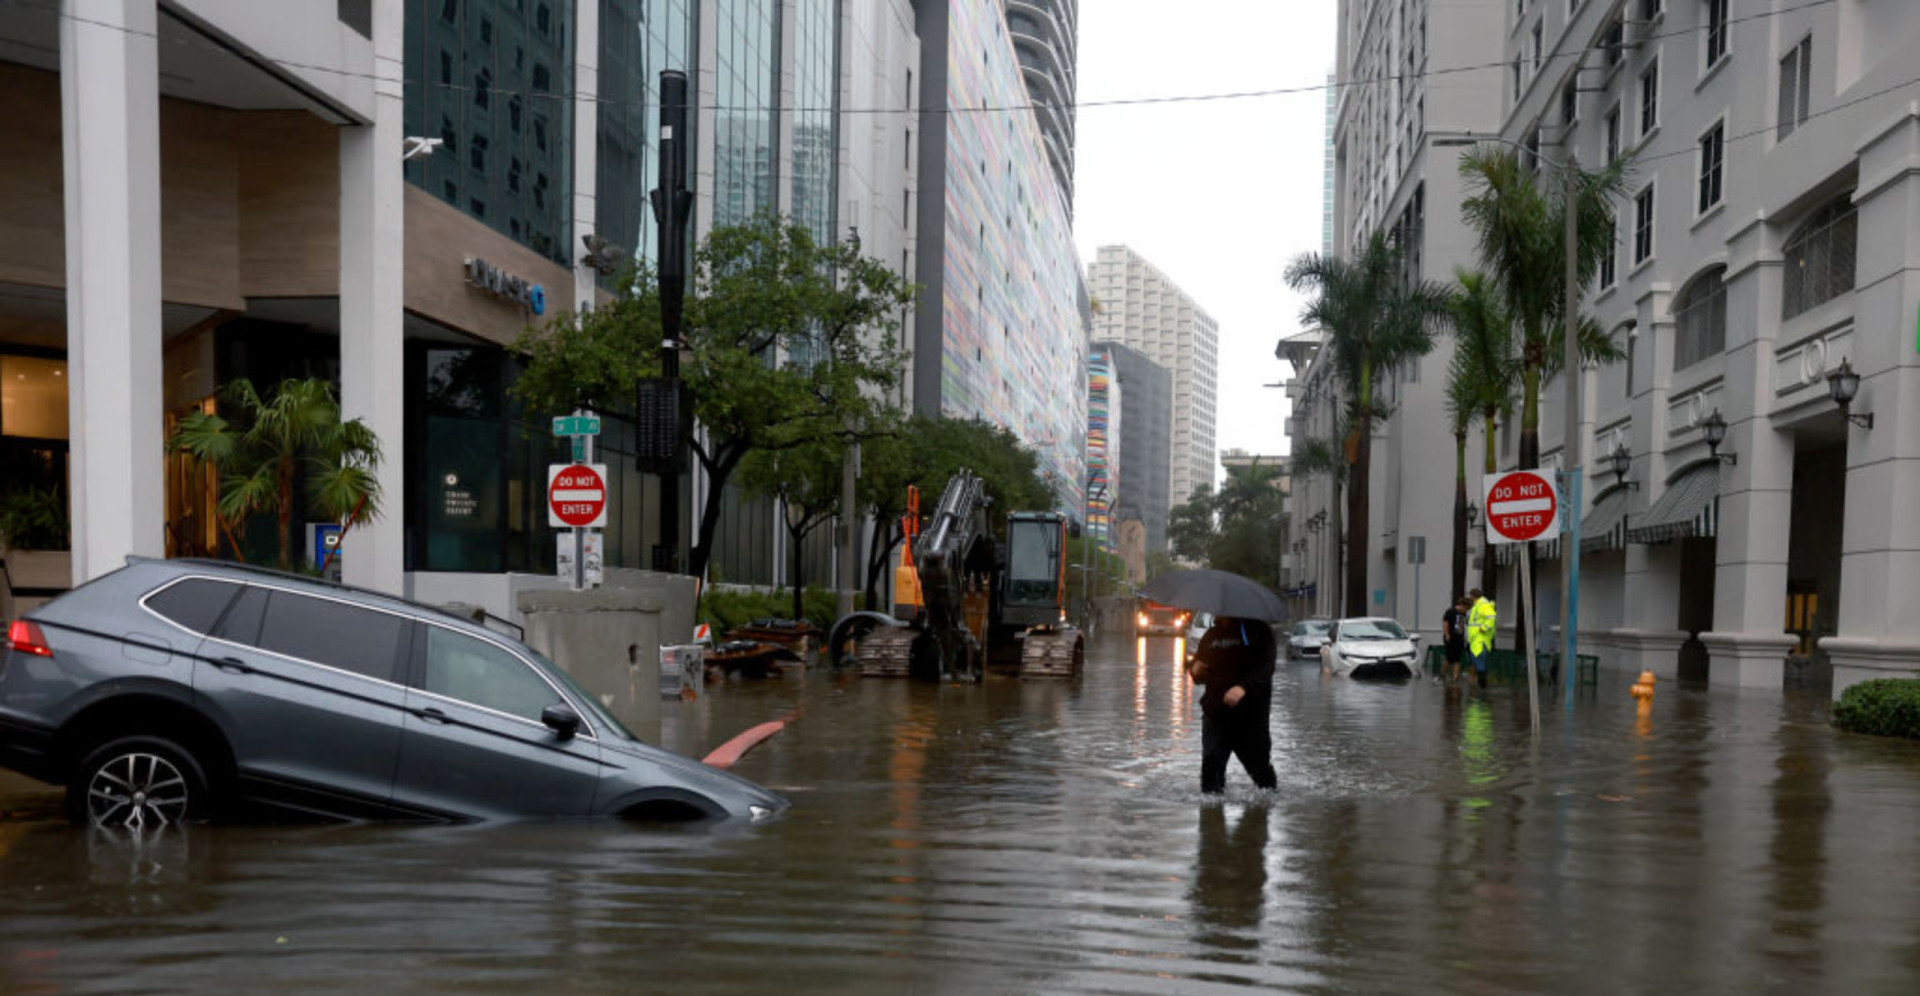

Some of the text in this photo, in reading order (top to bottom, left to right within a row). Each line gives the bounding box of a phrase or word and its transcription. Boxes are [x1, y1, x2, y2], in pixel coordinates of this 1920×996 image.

[559, 476, 595, 486] DO NOT
[1495, 483, 1544, 499] DO NOT
[562, 504, 593, 514] ENTER
[1502, 515, 1541, 528] ENTER
